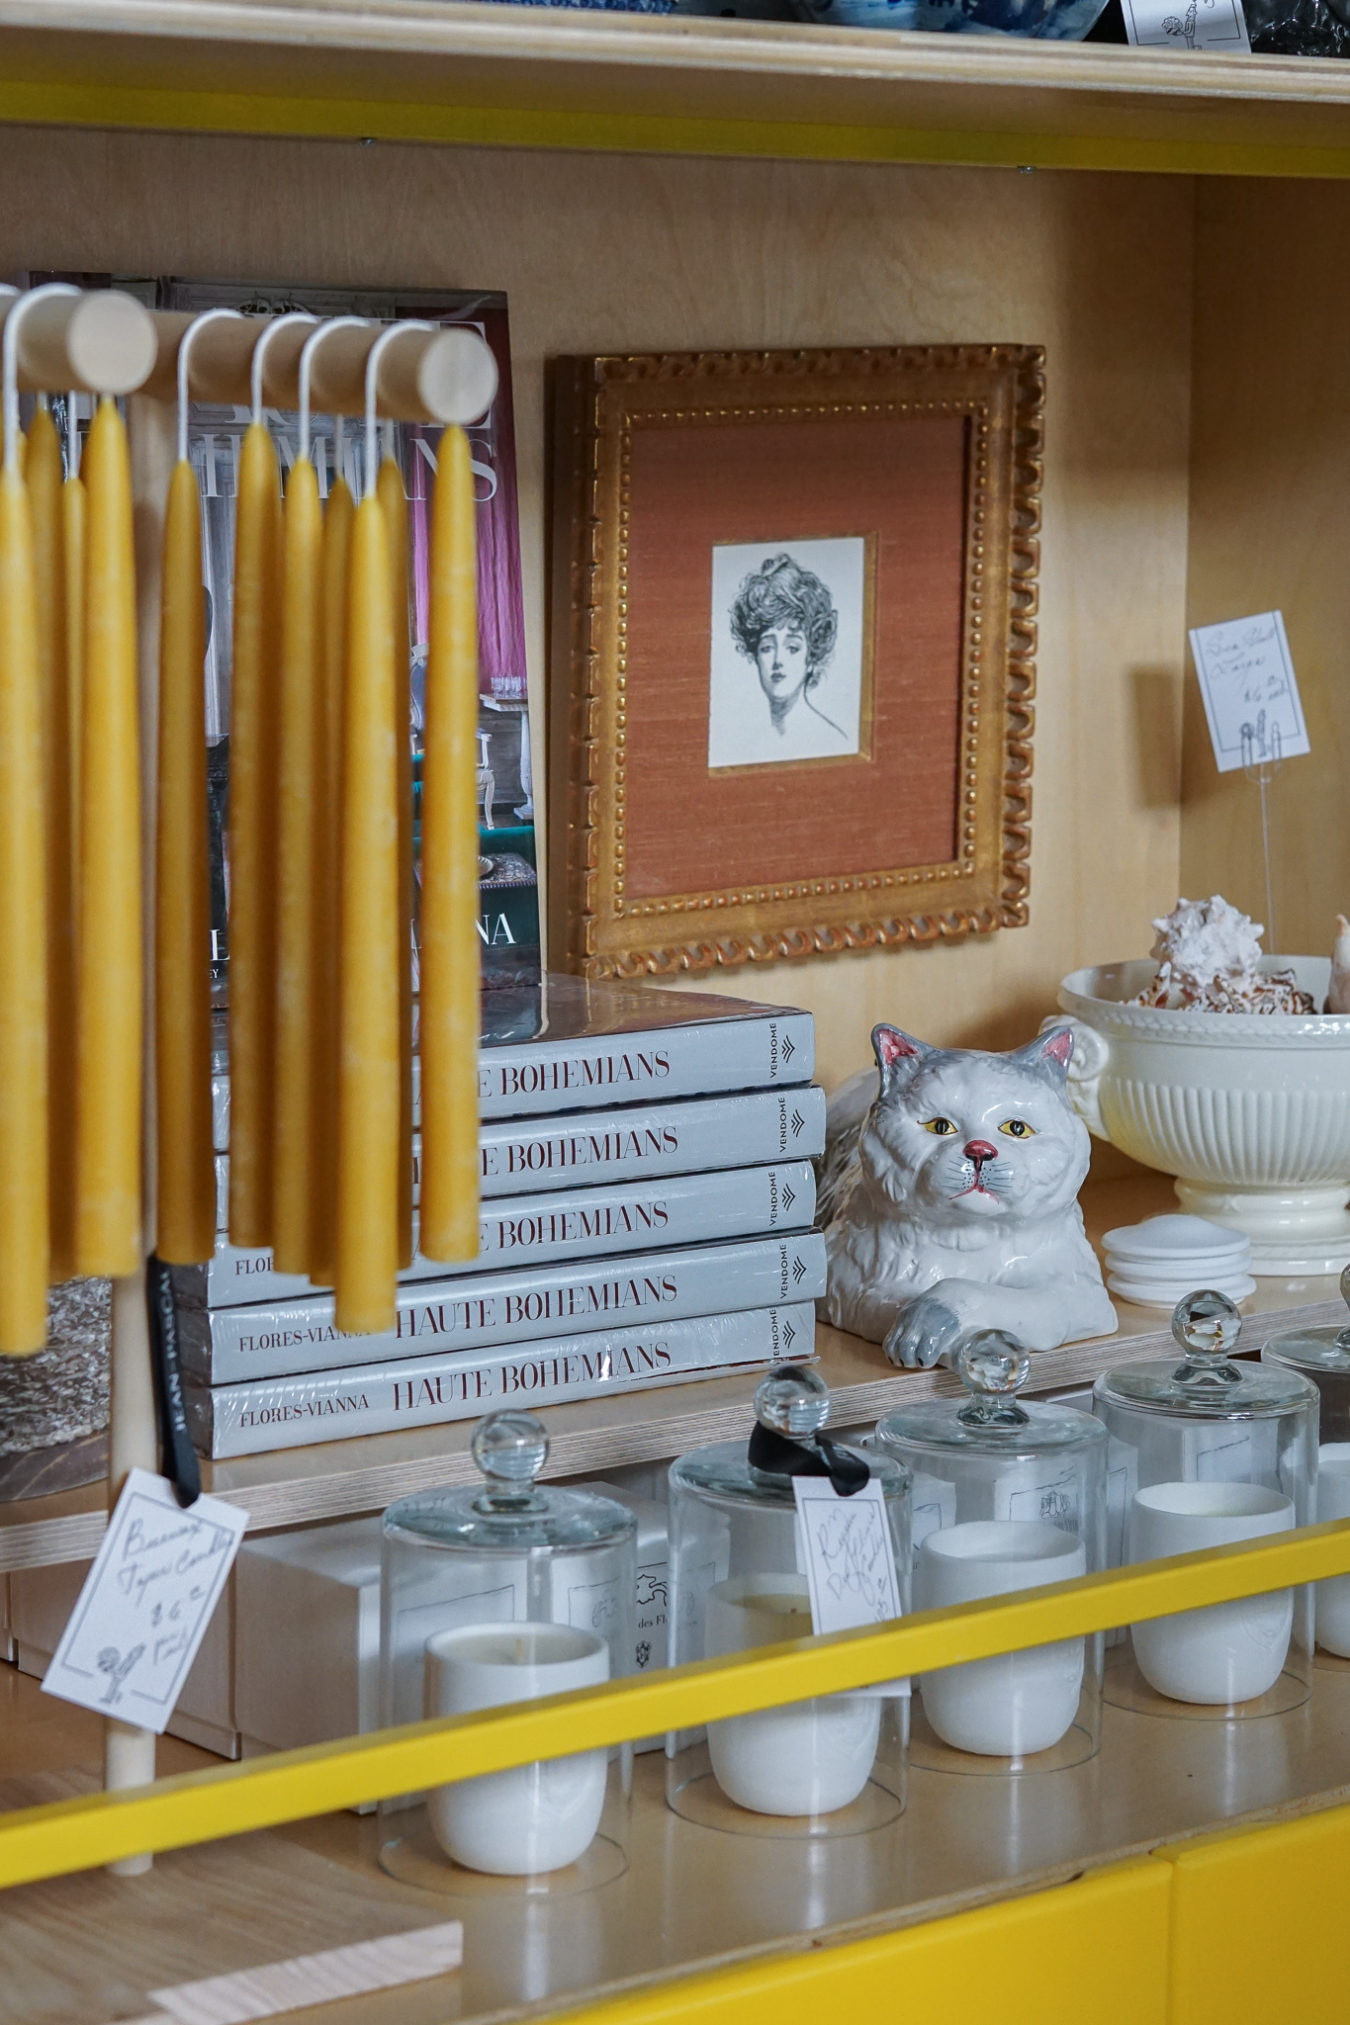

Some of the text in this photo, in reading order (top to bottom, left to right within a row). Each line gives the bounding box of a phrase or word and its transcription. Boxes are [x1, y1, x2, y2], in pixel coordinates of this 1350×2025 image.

[501, 1050, 670, 1096] BOHEMIANS
[769, 1022, 778, 1079] VENDOME
[507, 1125, 679, 1173] BOHEMIANS
[778, 1097, 787, 1153] VENDOME
[498, 1201, 669, 1249] BOHEMIANS
[768, 1171, 778, 1227] VENDOME
[779, 1244, 789, 1300] VENDOME
[239, 1274, 678, 1353] FLORES-VIA HAUTE BOHEMIANS
[239, 1341, 672, 1428] FLORES-VIANNA HAUTE BOHEMIANS
